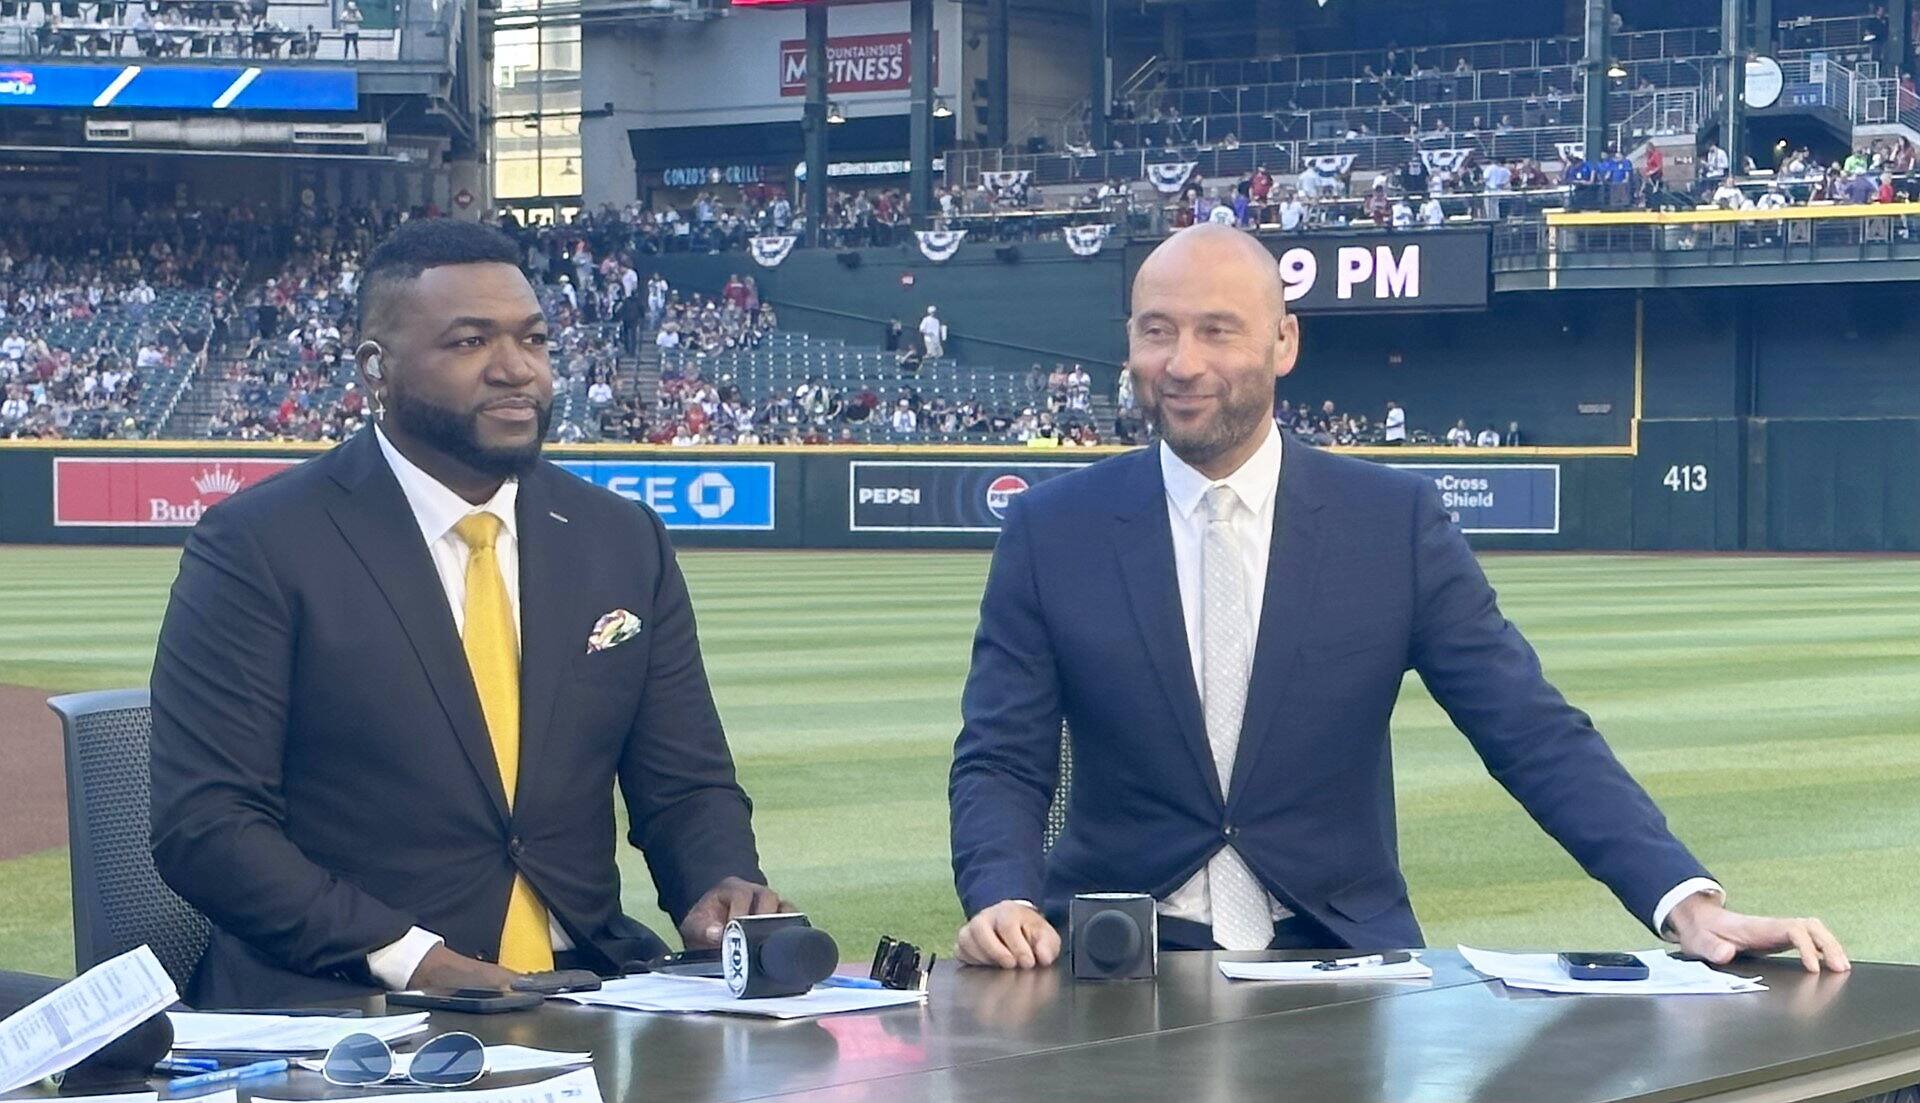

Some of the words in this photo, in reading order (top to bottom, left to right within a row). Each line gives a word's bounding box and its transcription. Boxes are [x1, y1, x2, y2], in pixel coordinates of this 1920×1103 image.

[826, 43, 903, 60] OUNTAINSIDE
[1338, 245, 1420, 300] PM
[1663, 464, 1708, 492] 413
[582, 476, 678, 513] SE
[858, 487, 921, 505] PEPSI
[1442, 491, 1494, 508] Shield
[150, 498, 209, 521] Bud
[731, 937, 743, 979] FOX
